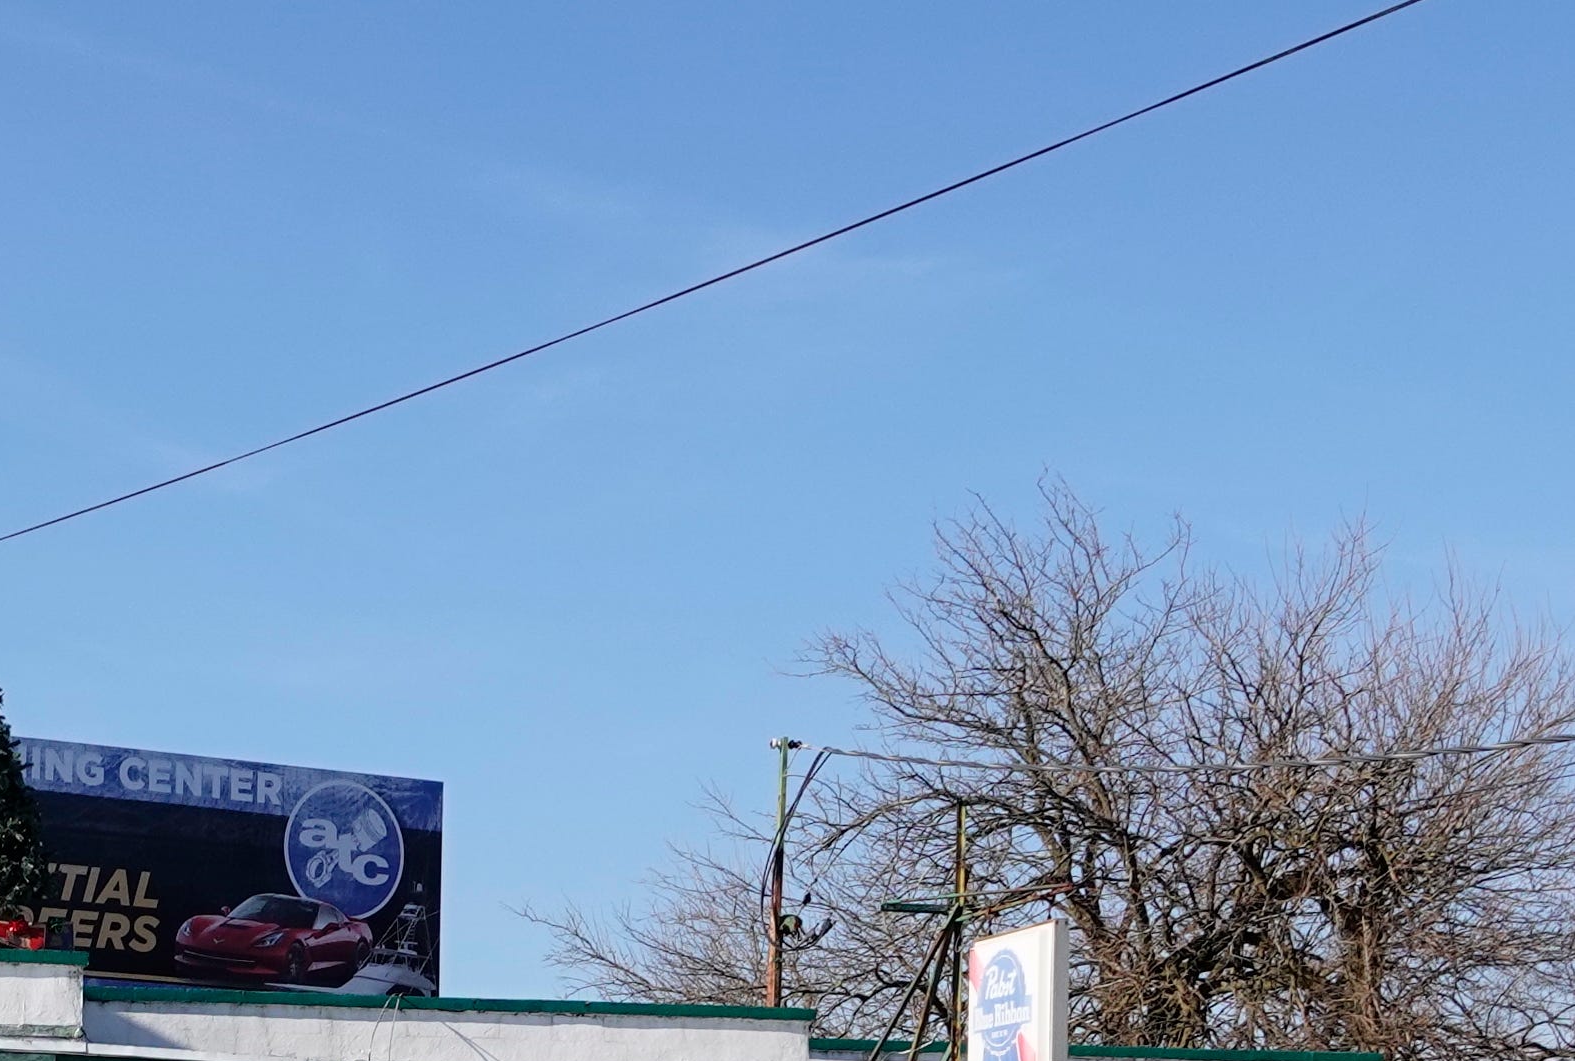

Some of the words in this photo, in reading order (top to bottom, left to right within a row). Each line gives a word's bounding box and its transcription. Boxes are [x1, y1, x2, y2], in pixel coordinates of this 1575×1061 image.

[119, 757, 284, 806] CENTER
[985, 965, 1017, 1000] Pabst
[994, 1001, 1030, 1027] Ribbon
